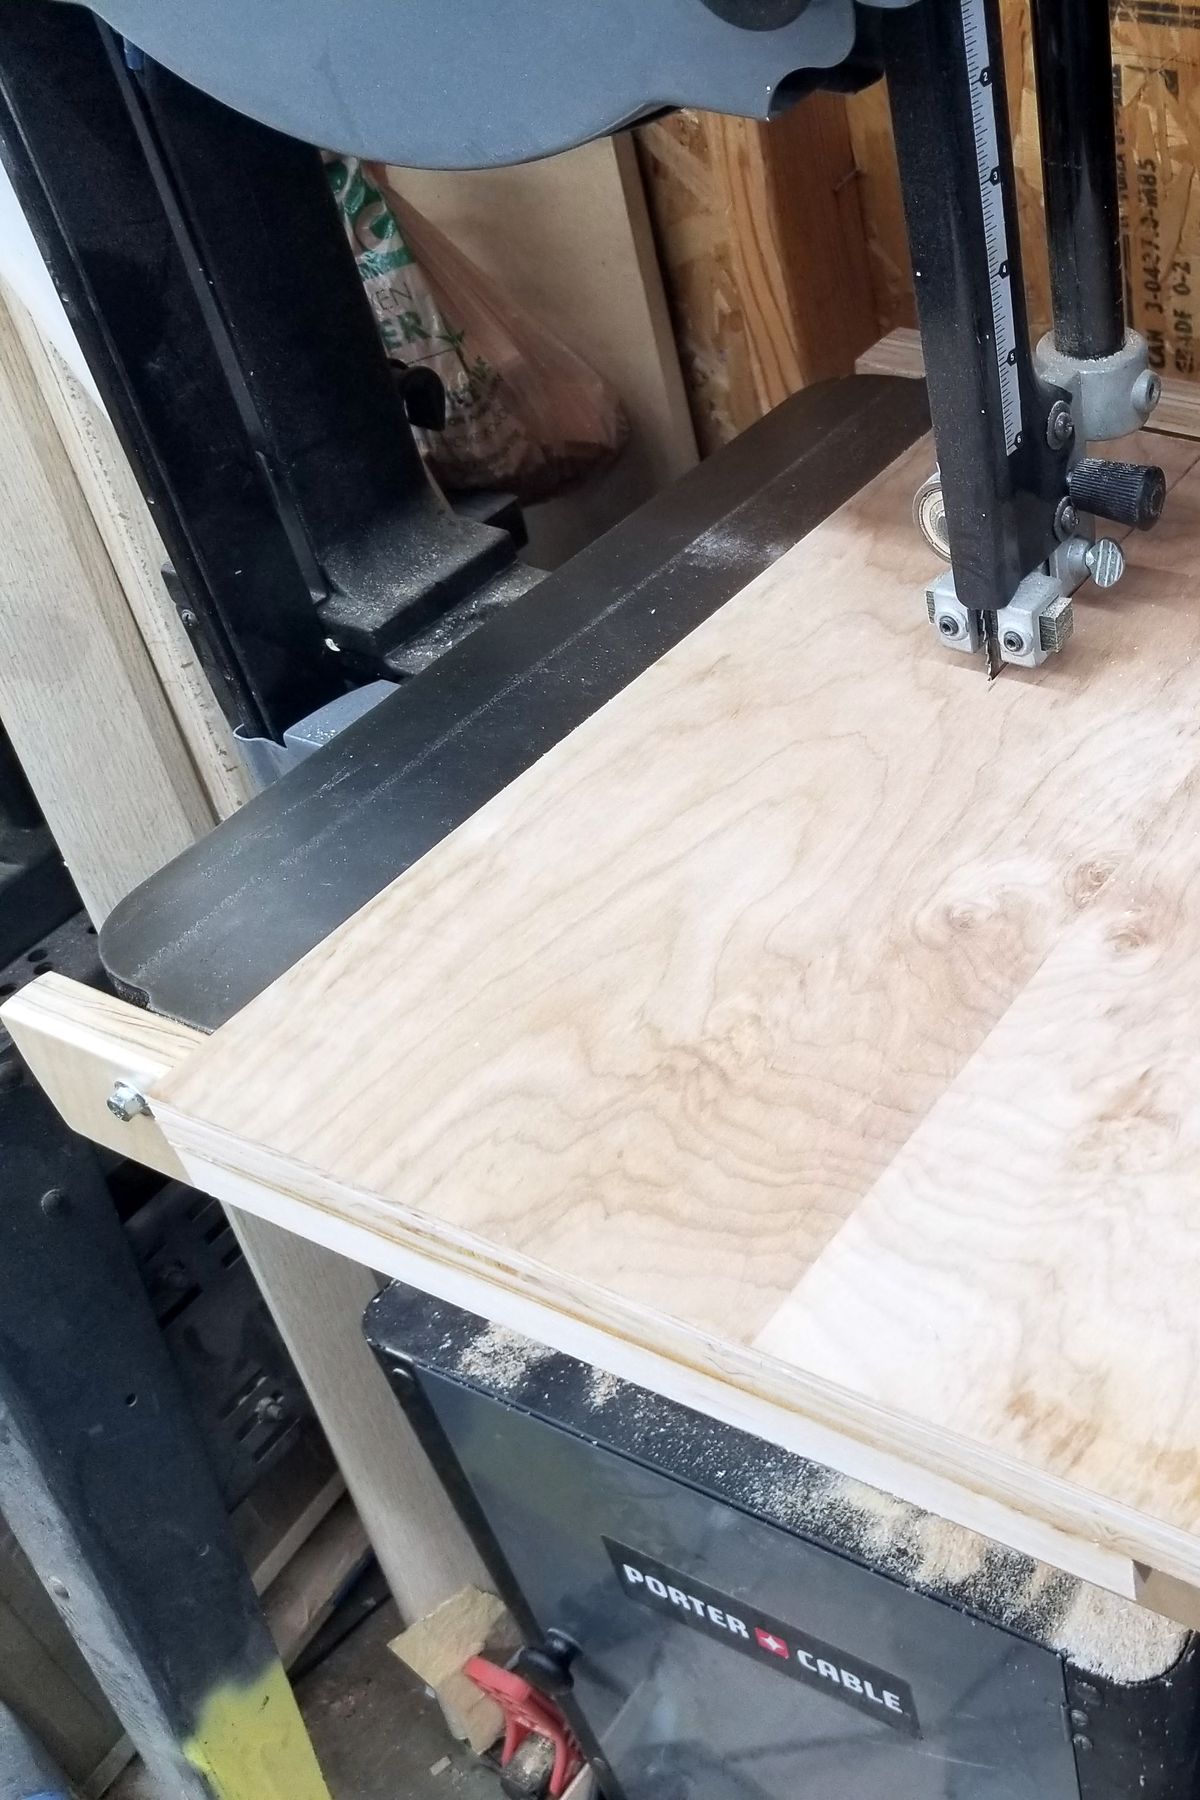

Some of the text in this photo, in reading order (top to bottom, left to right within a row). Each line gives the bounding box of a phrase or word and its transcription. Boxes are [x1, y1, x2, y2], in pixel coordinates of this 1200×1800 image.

[1148, 329, 1166, 369] CAN
[623, 1563, 904, 1713] PORTER CABLE
